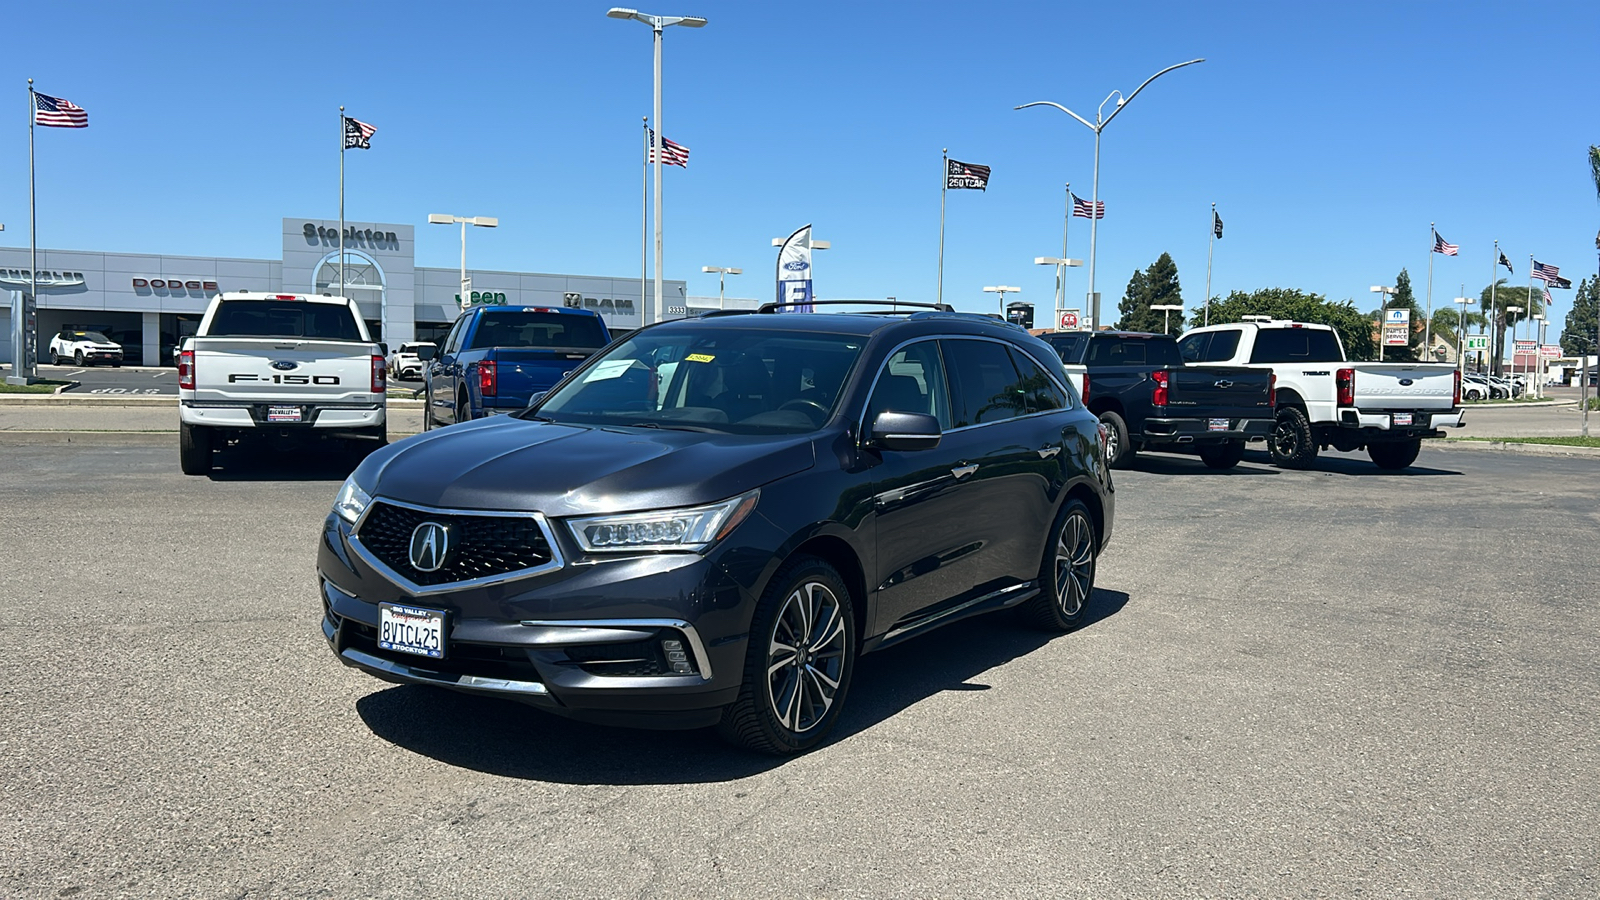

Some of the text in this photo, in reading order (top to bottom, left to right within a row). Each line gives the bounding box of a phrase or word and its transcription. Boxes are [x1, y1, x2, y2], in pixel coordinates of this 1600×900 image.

[949, 179, 964, 187] 250
[303, 223, 396, 243] Stockton
[788, 262, 805, 270] Ford
[132, 278, 218, 290] DODGE
[584, 298, 633, 309] RAM
[669, 306, 685, 314] 3333
[1477, 338, 1486, 347] EV
[228, 374, 341, 386] F-150
[1360, 387, 1411, 395] SUPER
[404, 607, 427, 617] VALLEY
[383, 620, 439, 650] 8VIC425
[392, 644, 429, 655] STOCKTON
